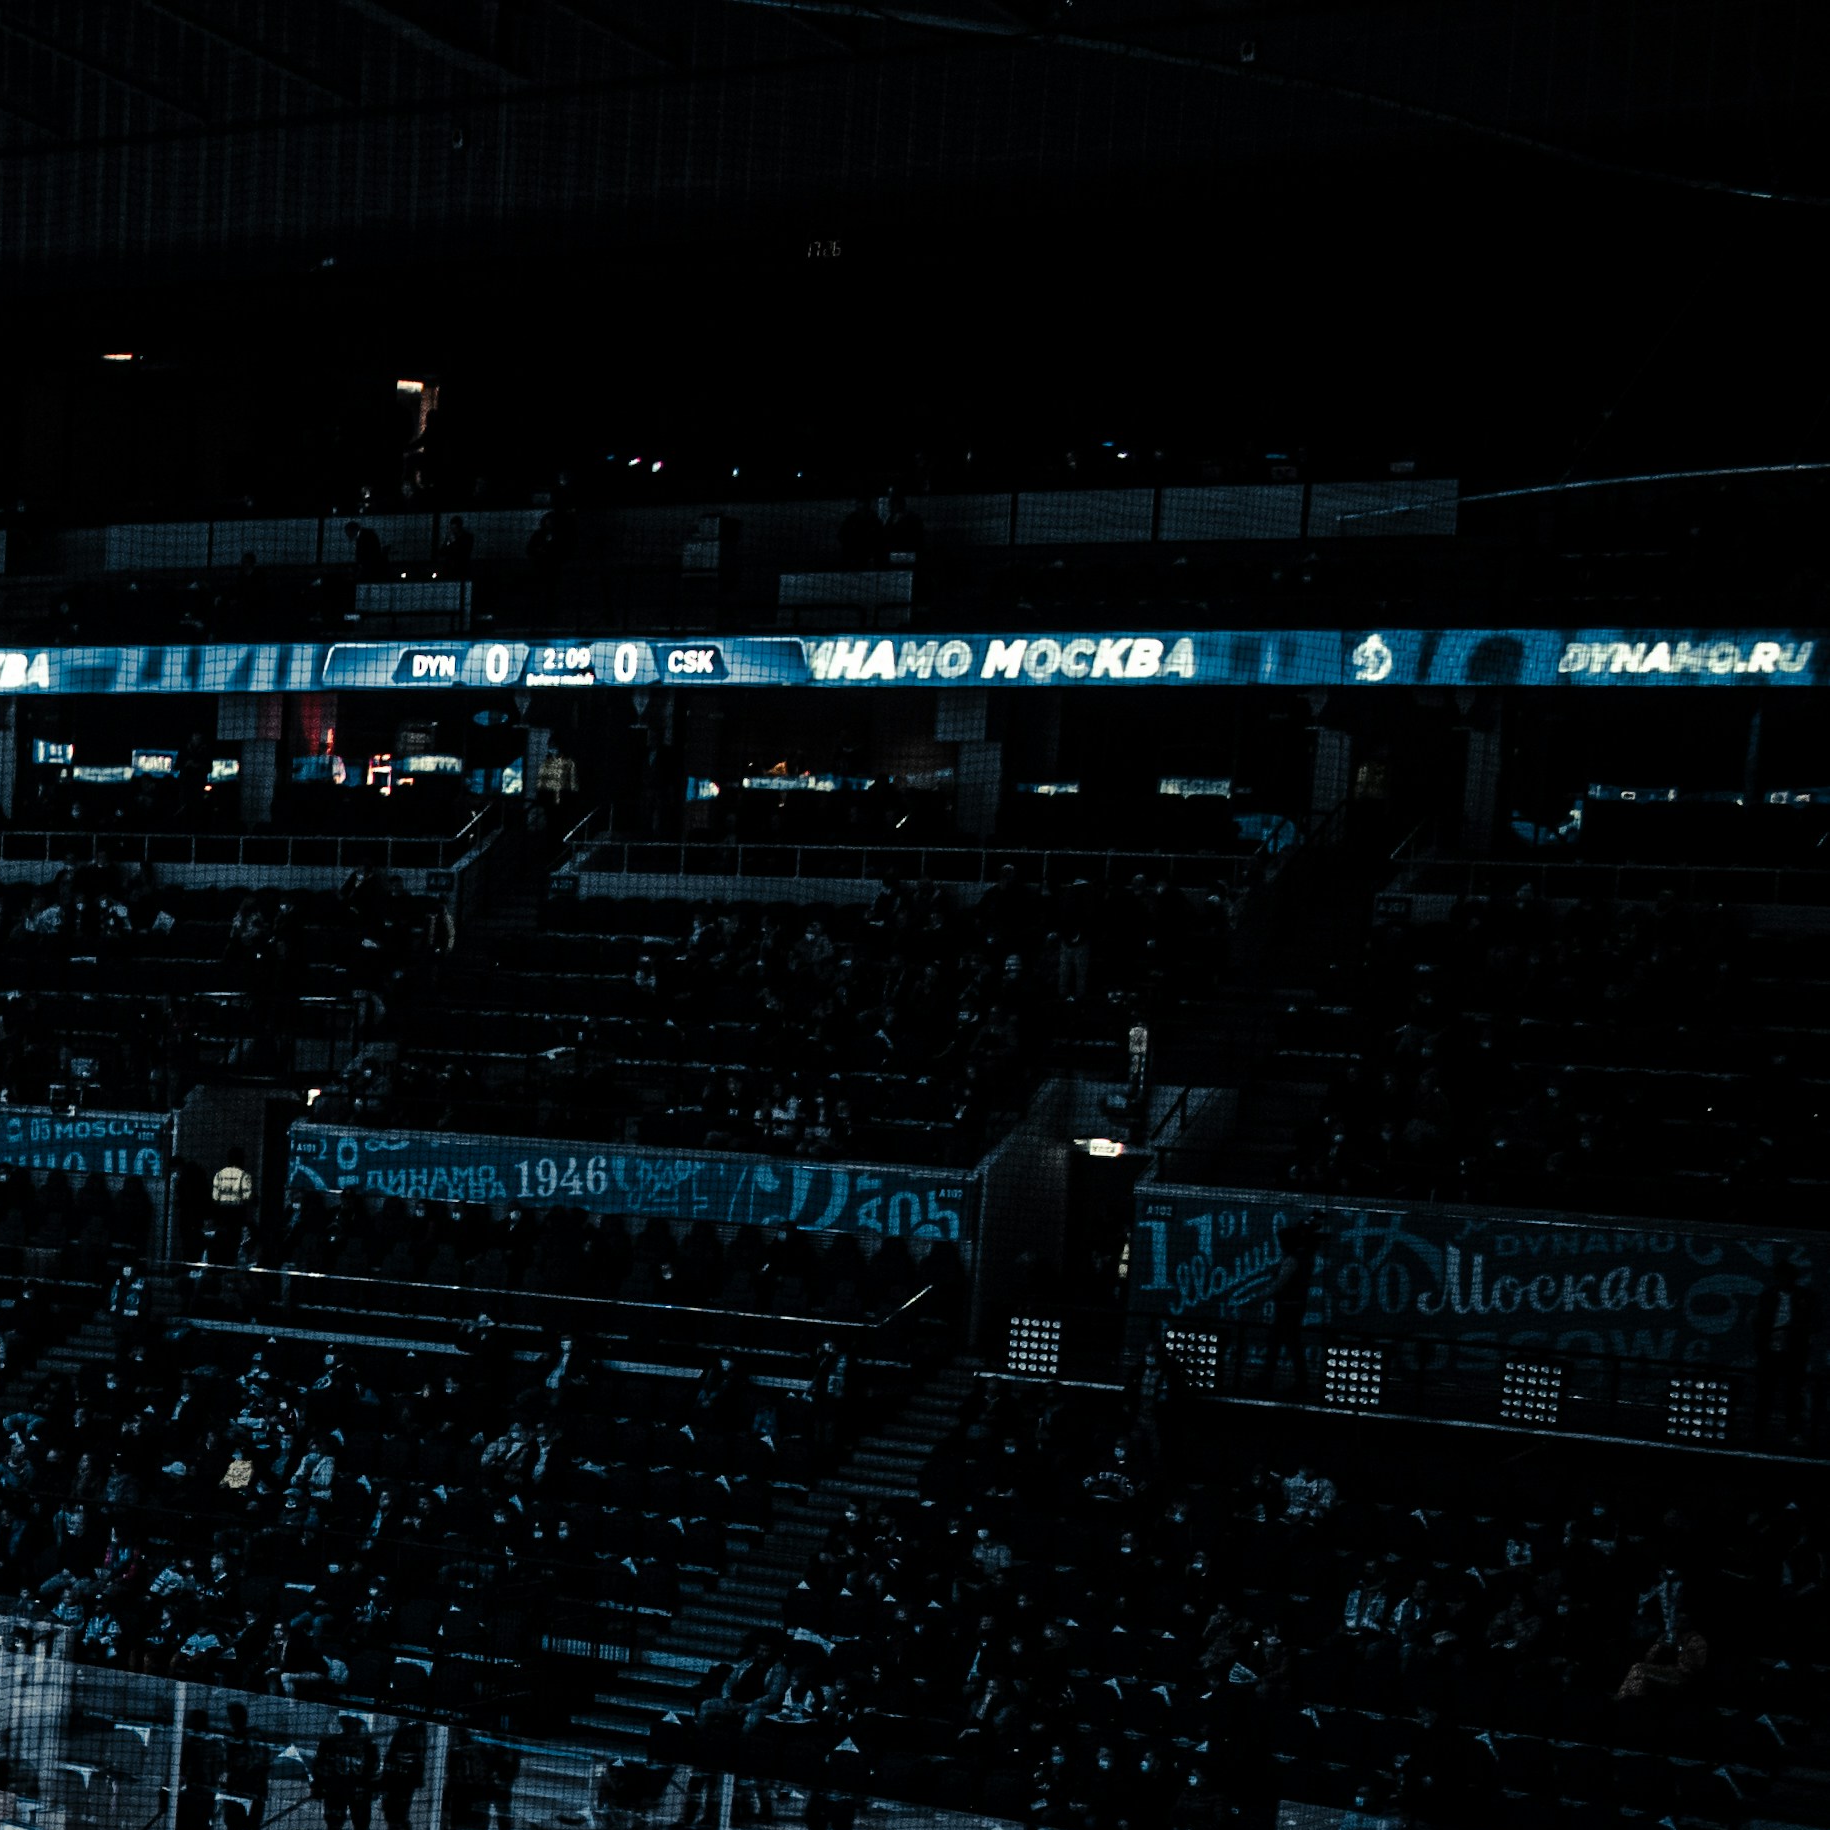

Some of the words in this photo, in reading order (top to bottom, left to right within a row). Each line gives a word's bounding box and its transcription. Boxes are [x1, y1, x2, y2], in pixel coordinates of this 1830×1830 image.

[412, 655, 456, 677] DYN
[485, 643, 509, 683] 0
[542, 647, 591, 670] 2:09
[613, 643, 638, 682] 0
[667, 650, 714, 673] CSK
[980, 637, 1197, 680] МОСКВА
[515, 1154, 608, 1200] 1946
[1416, 1243, 1677, 1317] Москва
